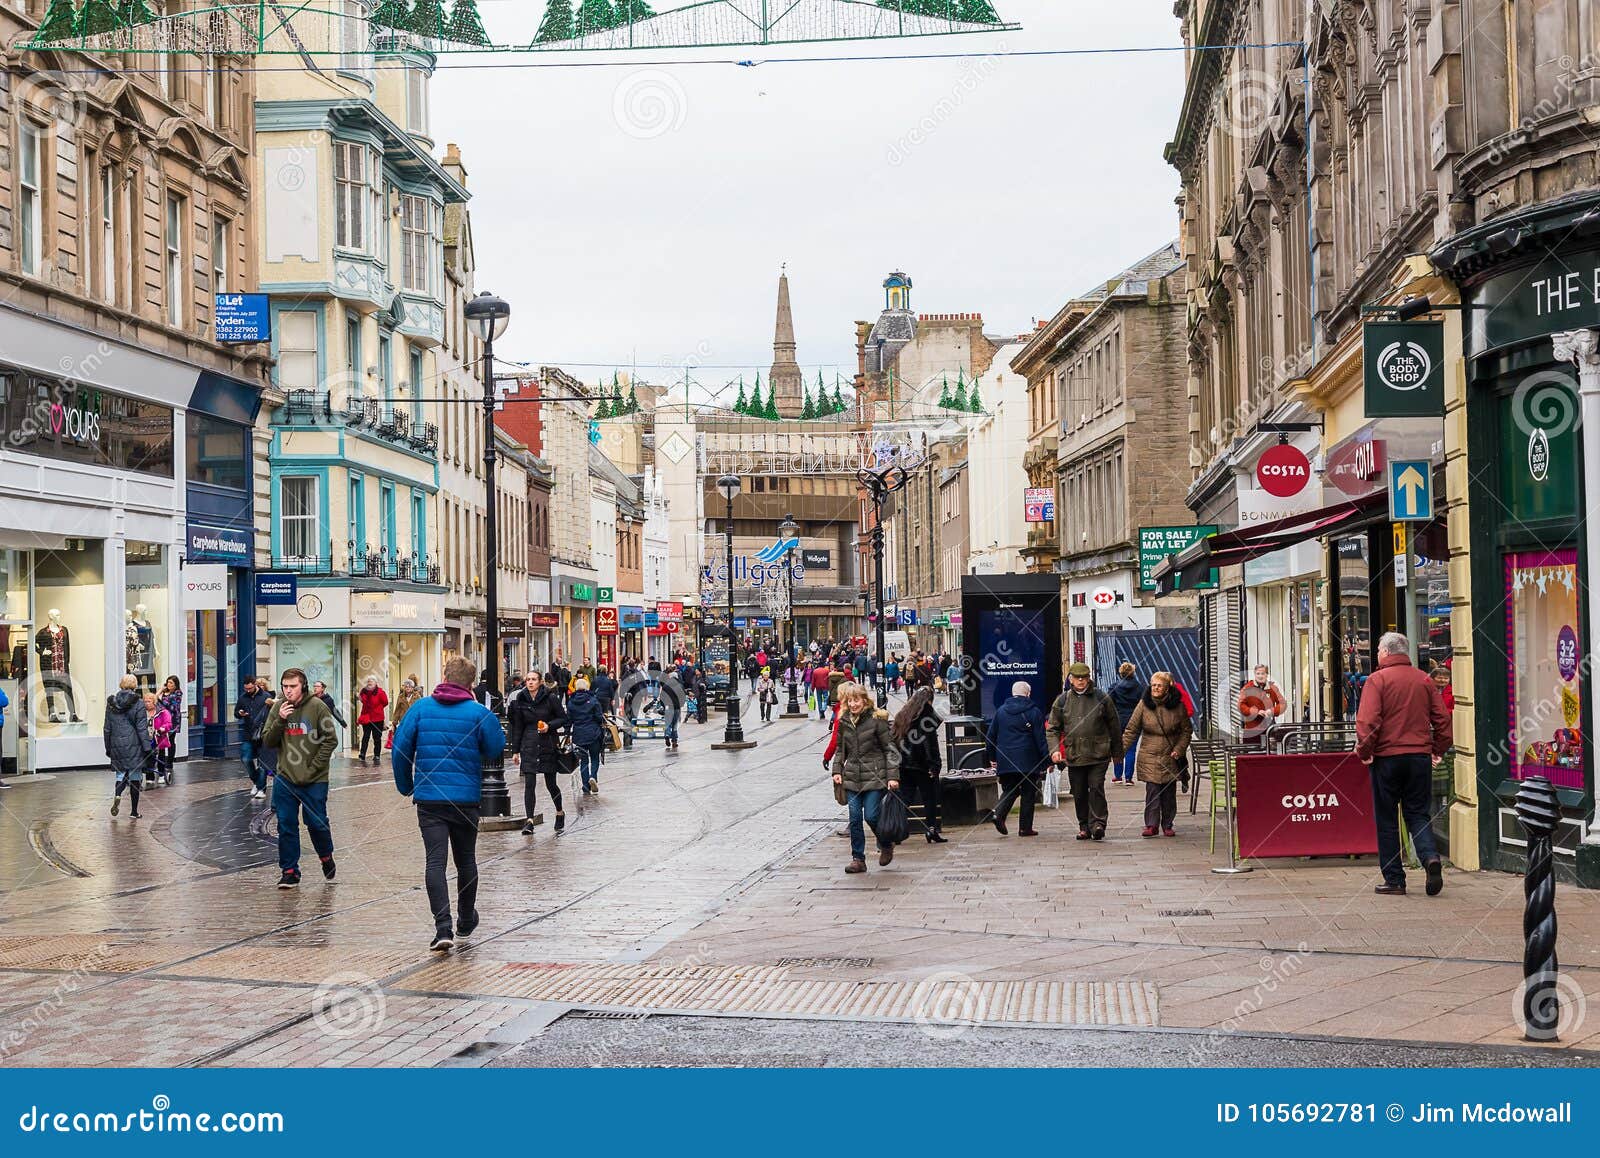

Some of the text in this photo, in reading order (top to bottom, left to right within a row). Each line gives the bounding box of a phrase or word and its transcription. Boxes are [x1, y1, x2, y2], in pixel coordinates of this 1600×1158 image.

[1531, 271, 1581, 316] THE
[1395, 357, 1414, 365] THE
[1389, 364, 1419, 374] BODY
[1390, 373, 1420, 382] SHOP
[63, 406, 100, 441] YOURS
[1534, 444, 1543, 453] THE
[1356, 440, 1375, 481] COSTA
[1532, 452, 1545, 463] BODY
[1261, 465, 1305, 477] COSTA
[1533, 462, 1545, 473] SHOP
[1142, 532, 1163, 540] FOR
[1166, 531, 1192, 540] SALE
[193, 536, 247, 553] Carphone Warehouse
[1142, 540, 1187, 549] MAY LET
[704, 555, 805, 588] ellgae
[196, 583, 222, 591] YOURS
[885, 642, 905, 650] KMail
[1281, 794, 1339, 809] COSTA
[1291, 813, 1331, 822] EST. 1971
